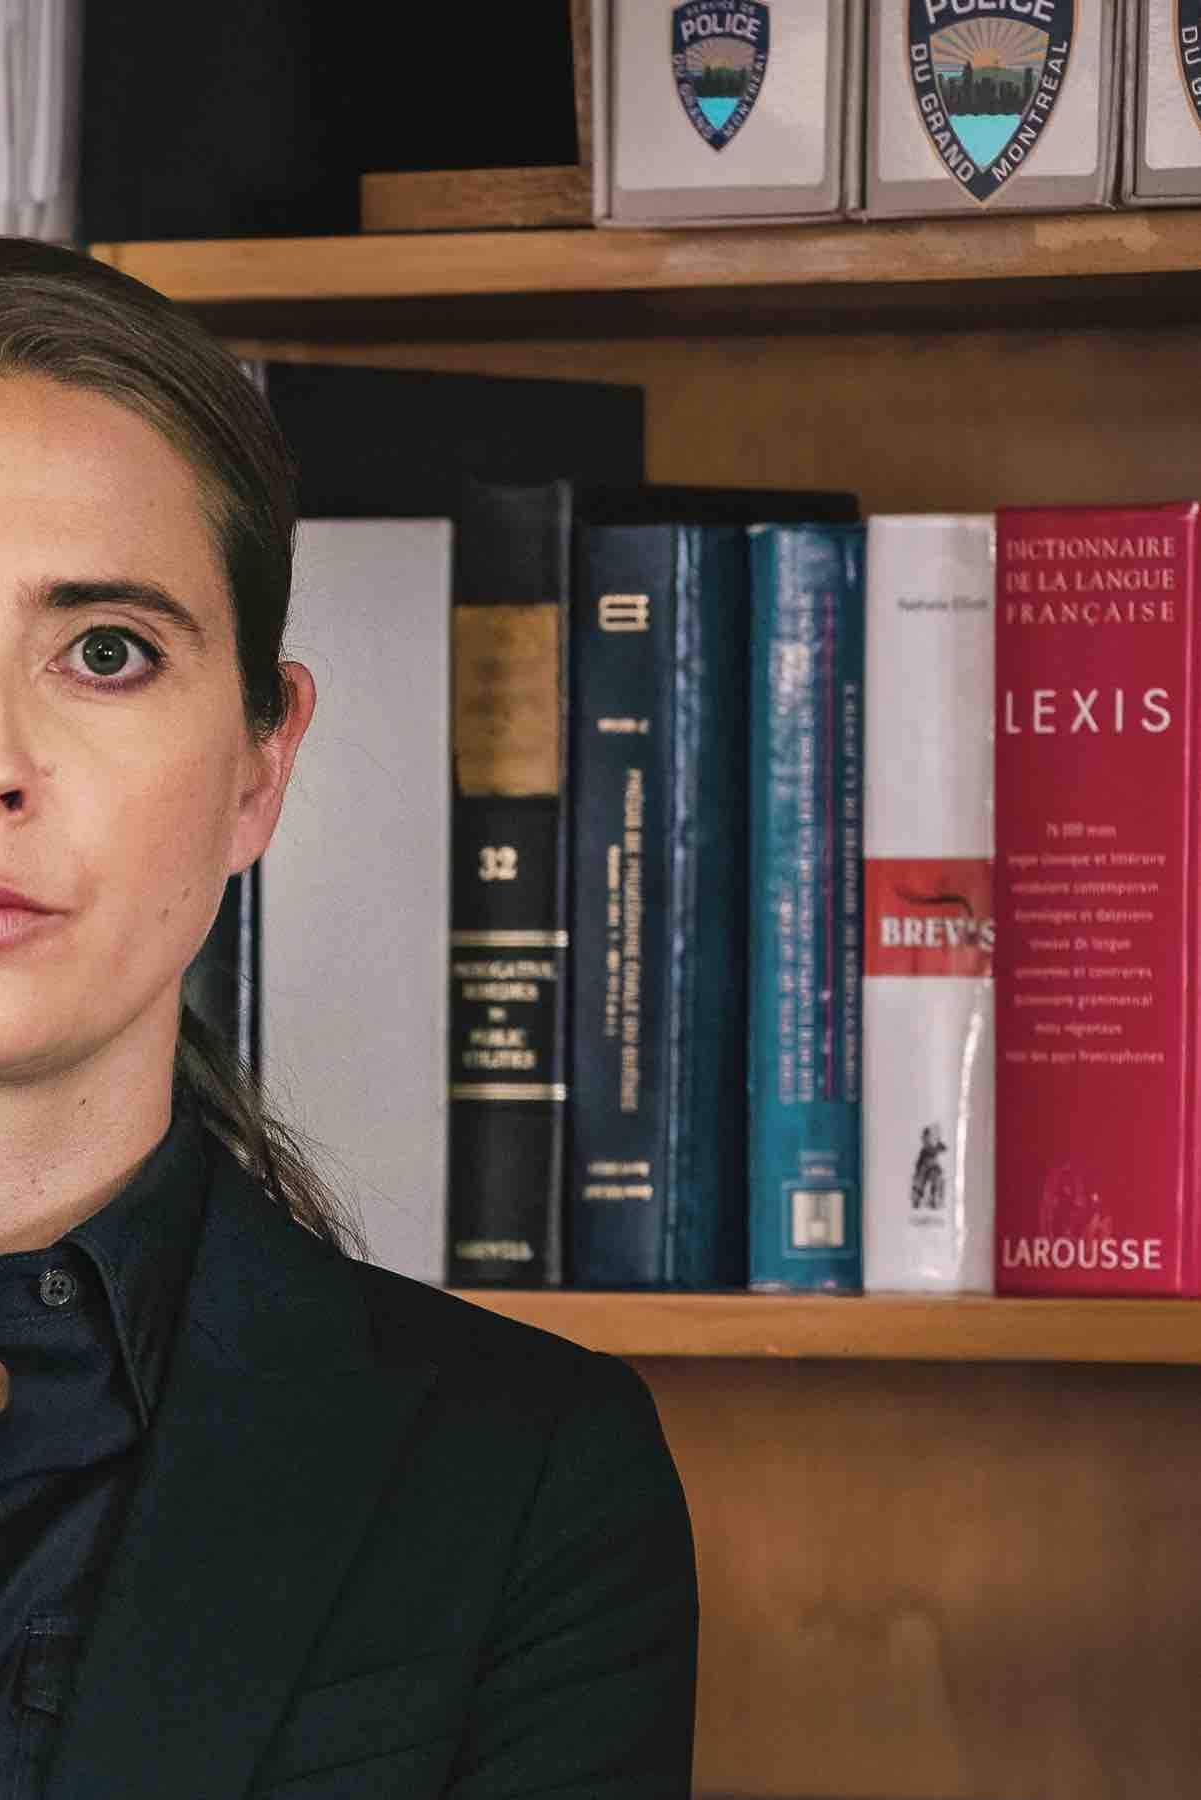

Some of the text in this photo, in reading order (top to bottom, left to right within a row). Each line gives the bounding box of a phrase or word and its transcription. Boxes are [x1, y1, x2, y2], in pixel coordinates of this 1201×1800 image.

[681, 13, 761, 41] POLICE
[1181, 25, 1201, 65] DU
[910, 43, 975, 183] DU GRAND
[991, 40, 1070, 183] MONTREAL
[1005, 536, 1175, 561] DICTIONNAIRE
[1005, 568, 1175, 592] DE LA LANGUE
[1005, 600, 1175, 627] FRANÇAISE
[1005, 687, 1171, 734] LEXIS
[1003, 1237, 1162, 1269] LAROUSSE
